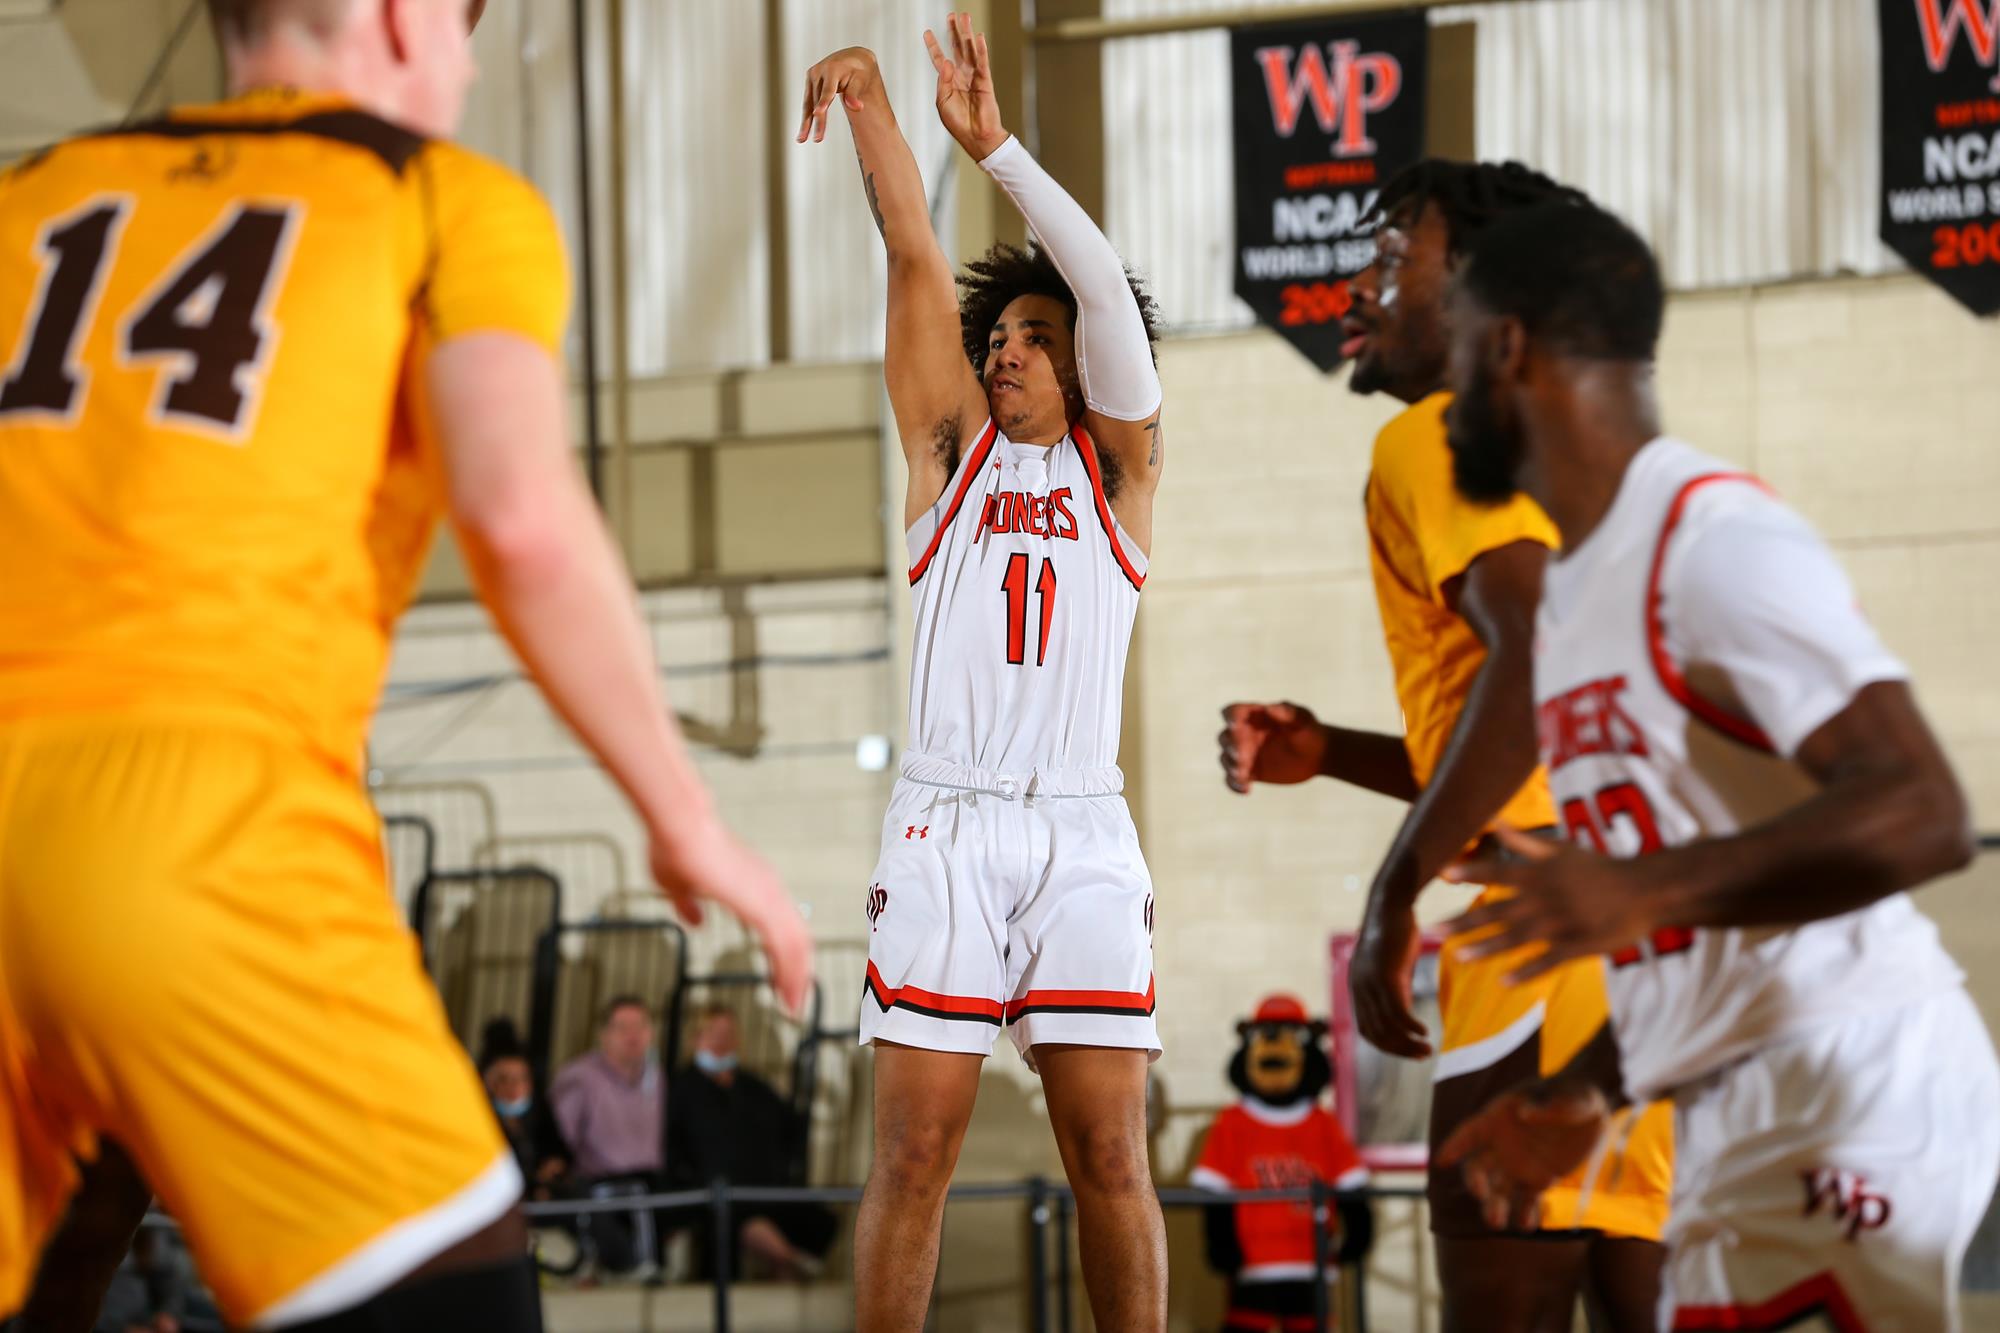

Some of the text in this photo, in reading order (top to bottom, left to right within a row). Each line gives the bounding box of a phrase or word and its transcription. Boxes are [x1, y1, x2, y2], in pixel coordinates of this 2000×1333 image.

[1254, 38, 1402, 157] WP
[1923, 131, 2000, 183] NCA
[1888, 184, 1985, 223] WORLD
[1242, 245, 1334, 280] WORLD
[0, 192, 306, 442] 14
[1279, 281, 1354, 326] 200
[1000, 552, 1057, 667] 11
[1799, 1167, 1892, 1243] WP
